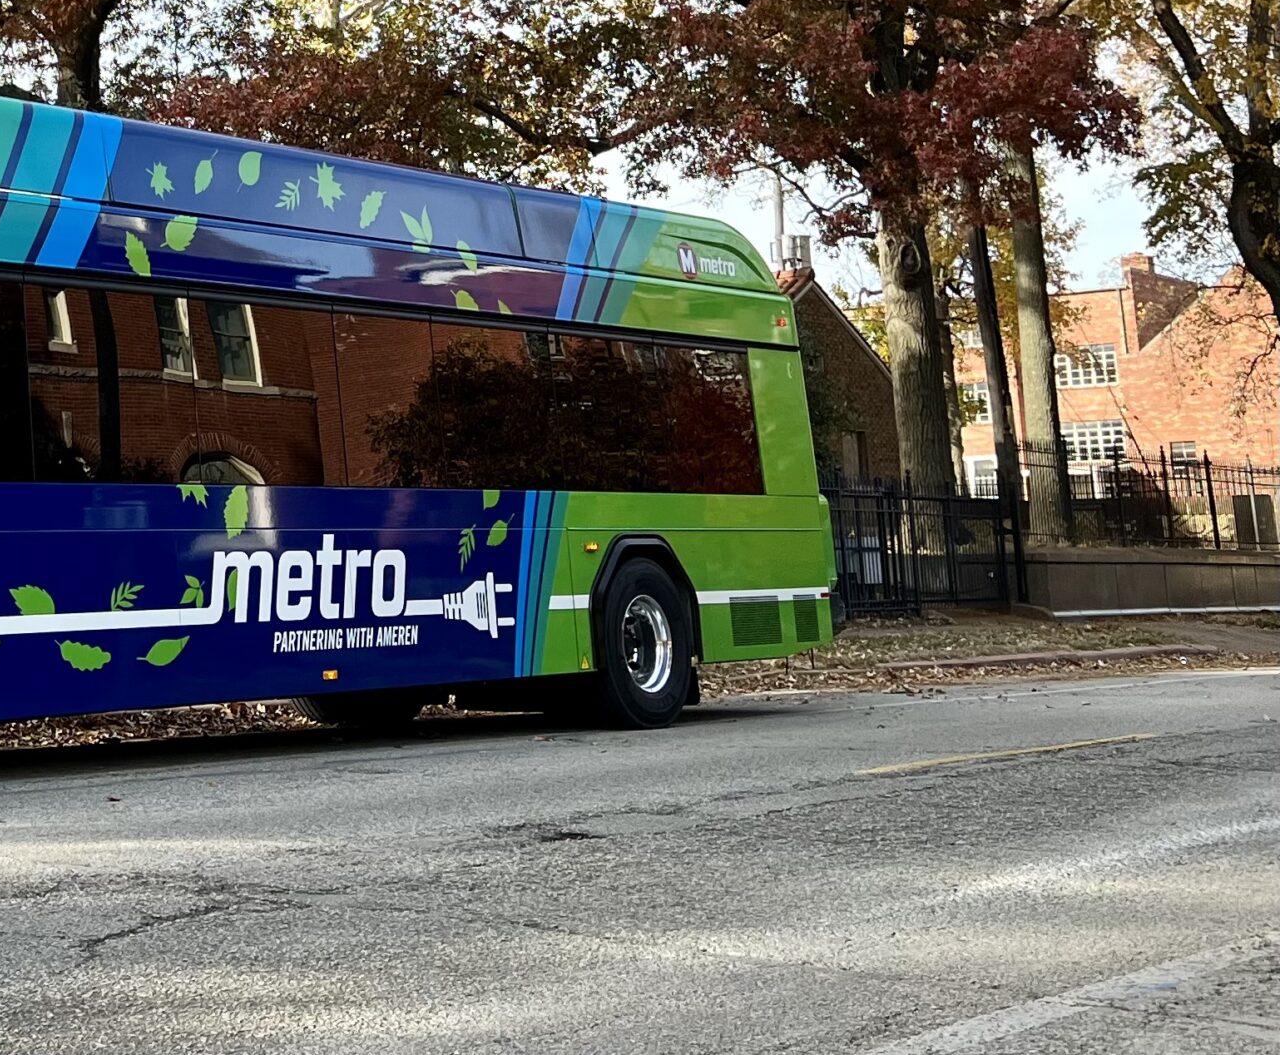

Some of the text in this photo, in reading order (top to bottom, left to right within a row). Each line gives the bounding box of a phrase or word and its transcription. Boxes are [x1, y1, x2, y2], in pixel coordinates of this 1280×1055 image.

[679, 247, 737, 277] M metro
[207, 533, 407, 624] metro
[273, 625, 419, 653] PARTNERING WITH AMEREN
